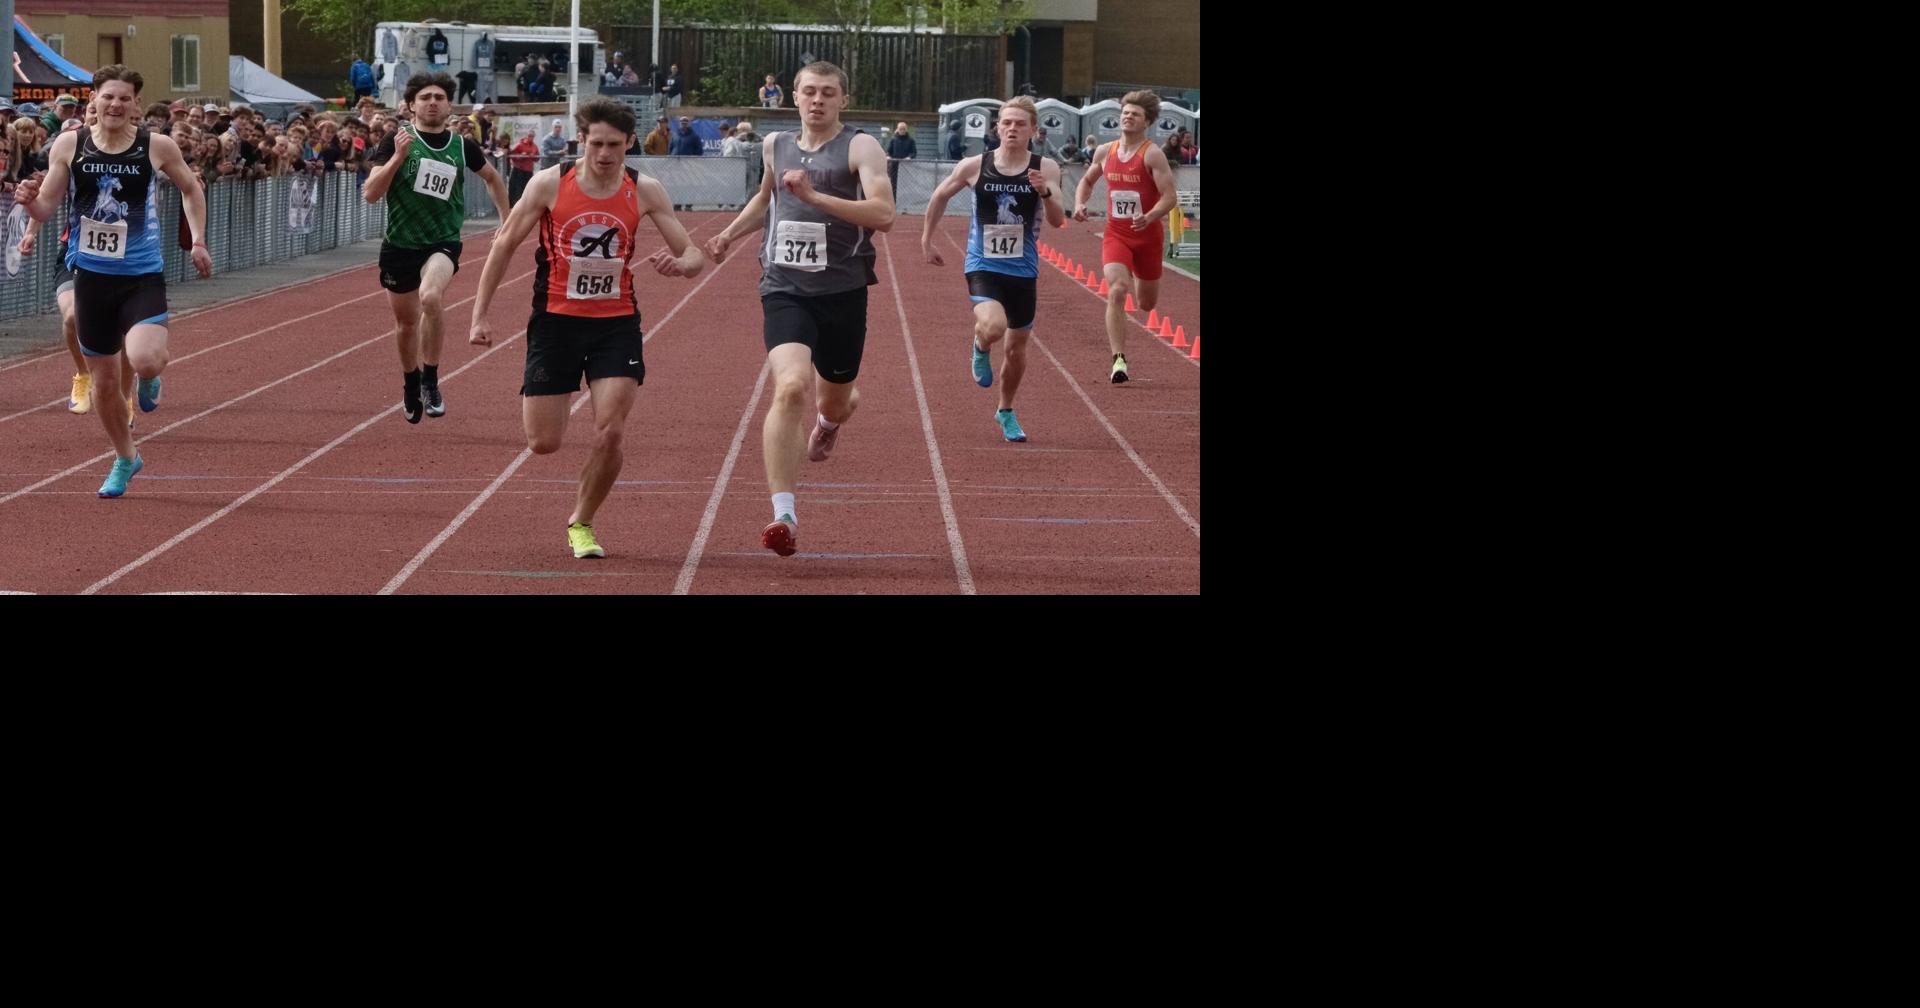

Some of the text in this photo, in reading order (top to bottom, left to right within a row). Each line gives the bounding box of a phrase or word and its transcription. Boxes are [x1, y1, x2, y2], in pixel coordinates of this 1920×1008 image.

[82, 163, 140, 175] CHUGIAK
[421, 172, 449, 195] 198
[984, 183, 1032, 193] CHUGIAK
[1116, 201, 1137, 215] 677
[577, 215, 618, 228] WEST
[87, 230, 119, 253] 163
[991, 238, 1018, 255] 147
[784, 239, 819, 264] 374
[576, 274, 614, 295] 658
